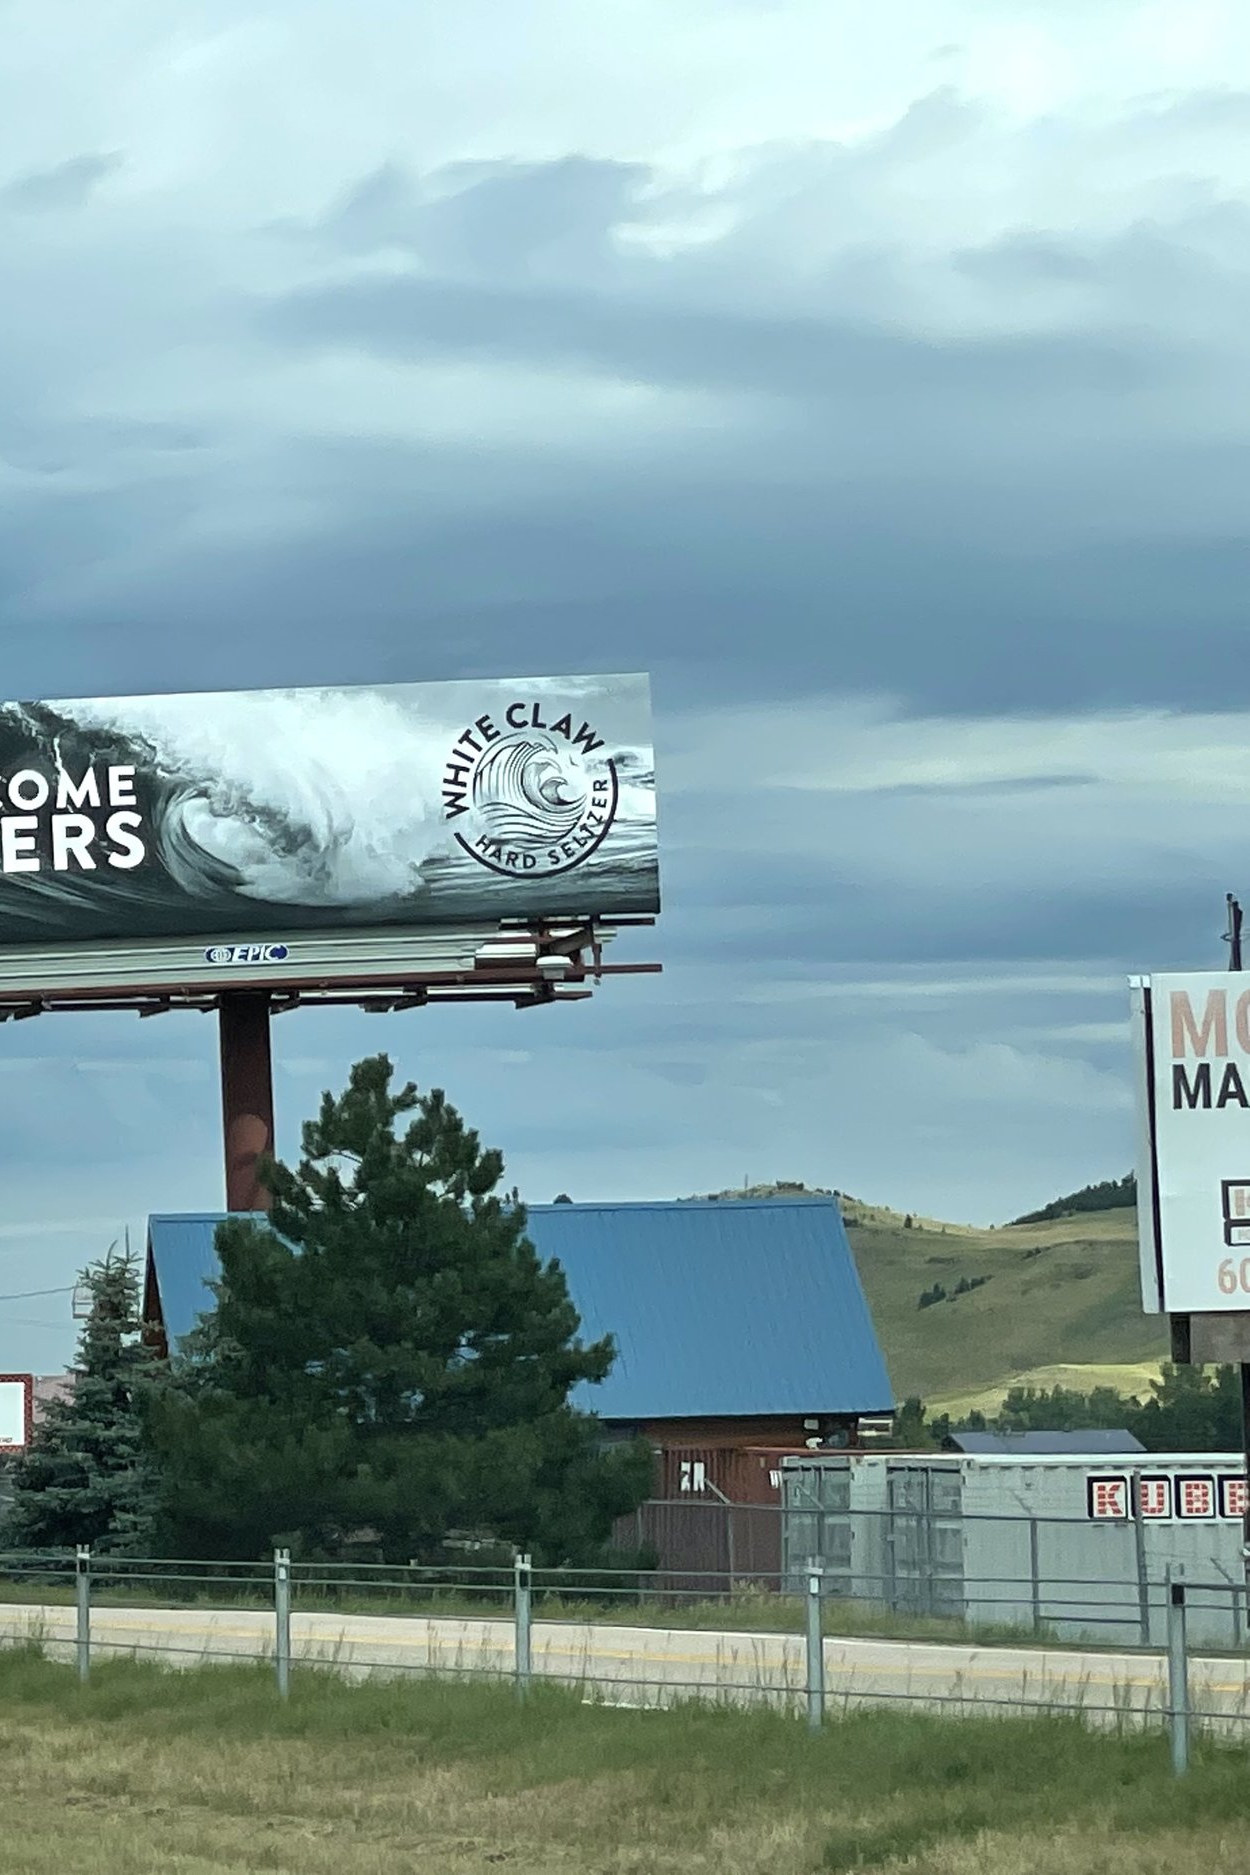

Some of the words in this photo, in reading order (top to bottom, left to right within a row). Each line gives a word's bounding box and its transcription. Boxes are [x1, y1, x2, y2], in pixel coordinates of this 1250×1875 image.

[442, 714, 501, 820] WHITE
[506, 702, 605, 755] CLAW
[474, 833, 537, 869] HARD
[547, 778, 609, 866] SELTZER
[231, 944, 283, 962] EPIC
[1097, 1483, 1248, 1515] KUBE
